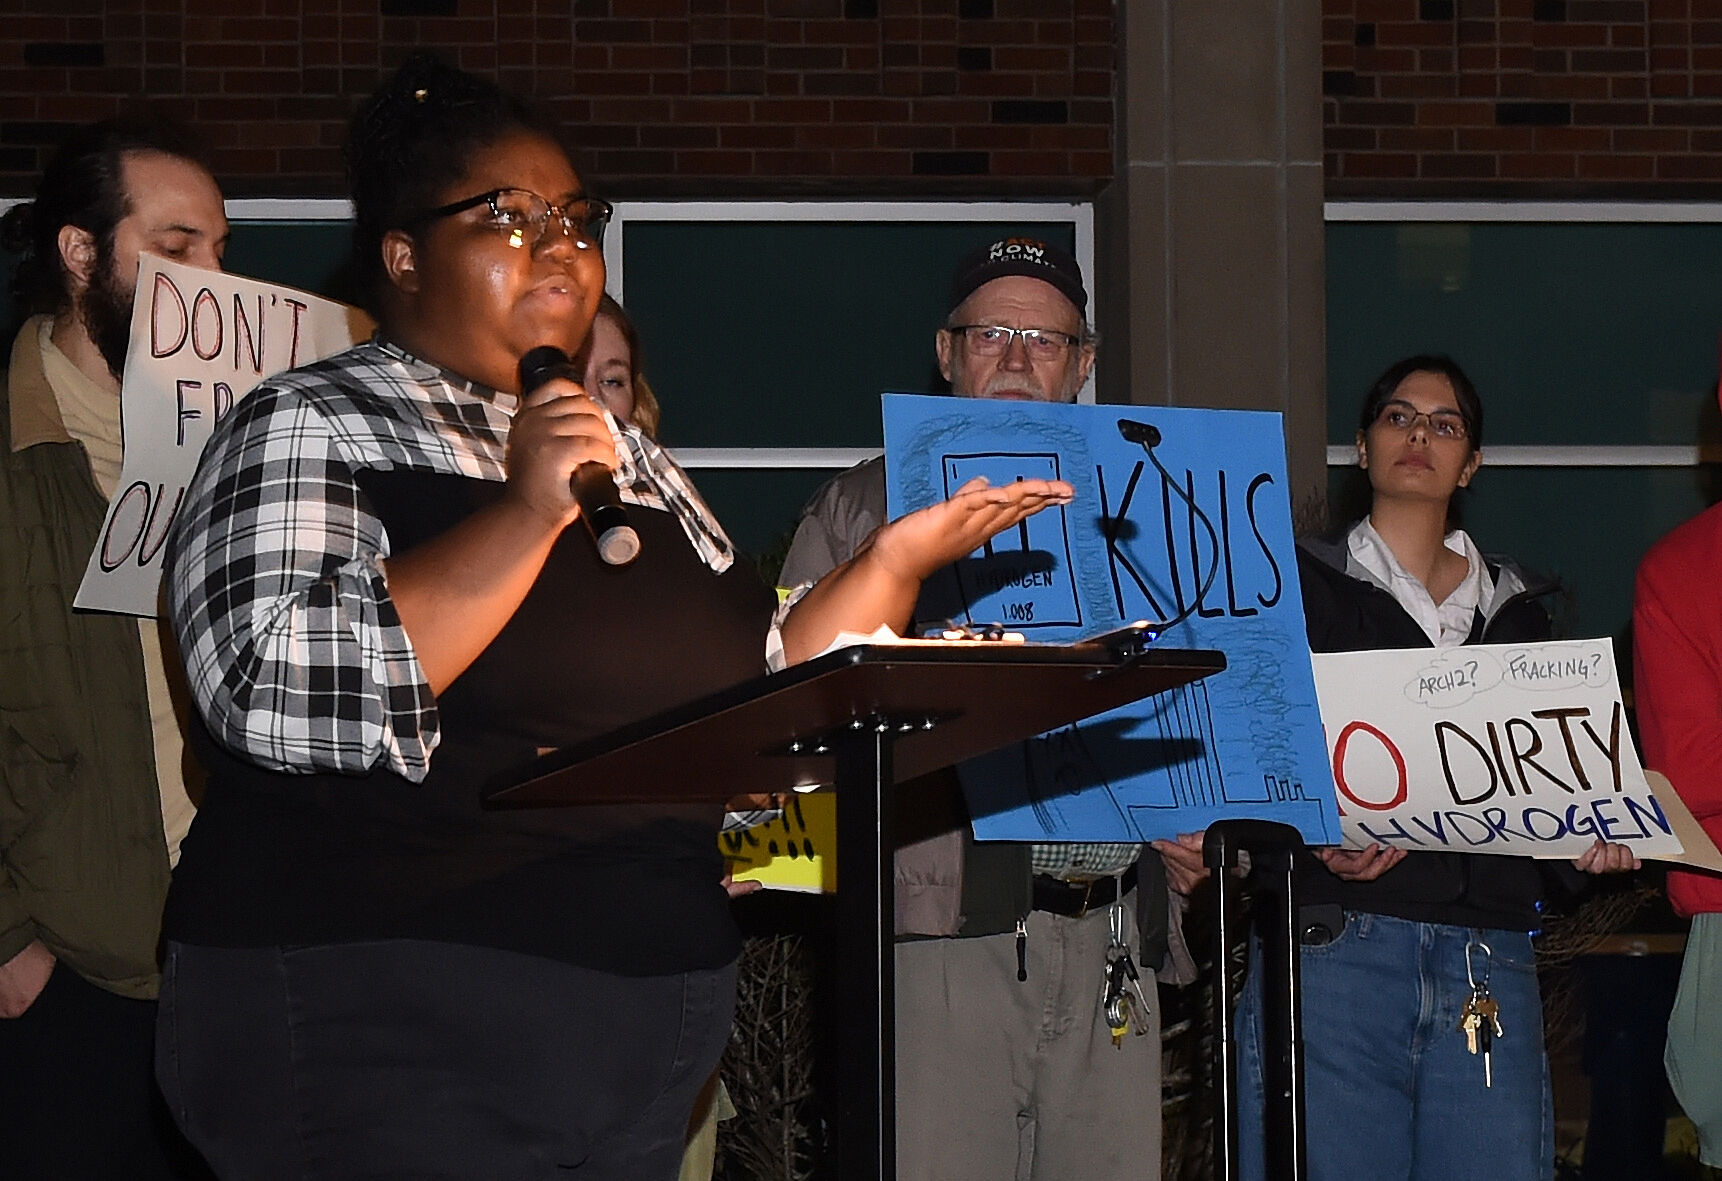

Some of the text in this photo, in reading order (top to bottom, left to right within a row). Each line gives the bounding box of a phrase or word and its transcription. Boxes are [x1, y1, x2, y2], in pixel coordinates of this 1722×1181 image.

[990, 244, 1044, 260] NOW
[150, 271, 307, 376] DON'T
[100, 480, 184, 573] OU
[1096, 460, 1282, 622] KILLS
[1001, 601, 1034, 622] 1.008
[1418, 660, 1479, 698] ARCH2?
[1510, 653, 1602, 681] FRACKING?
[1321, 701, 1621, 817] O DIRTY
[1356, 794, 1673, 847] HYDROGEN
